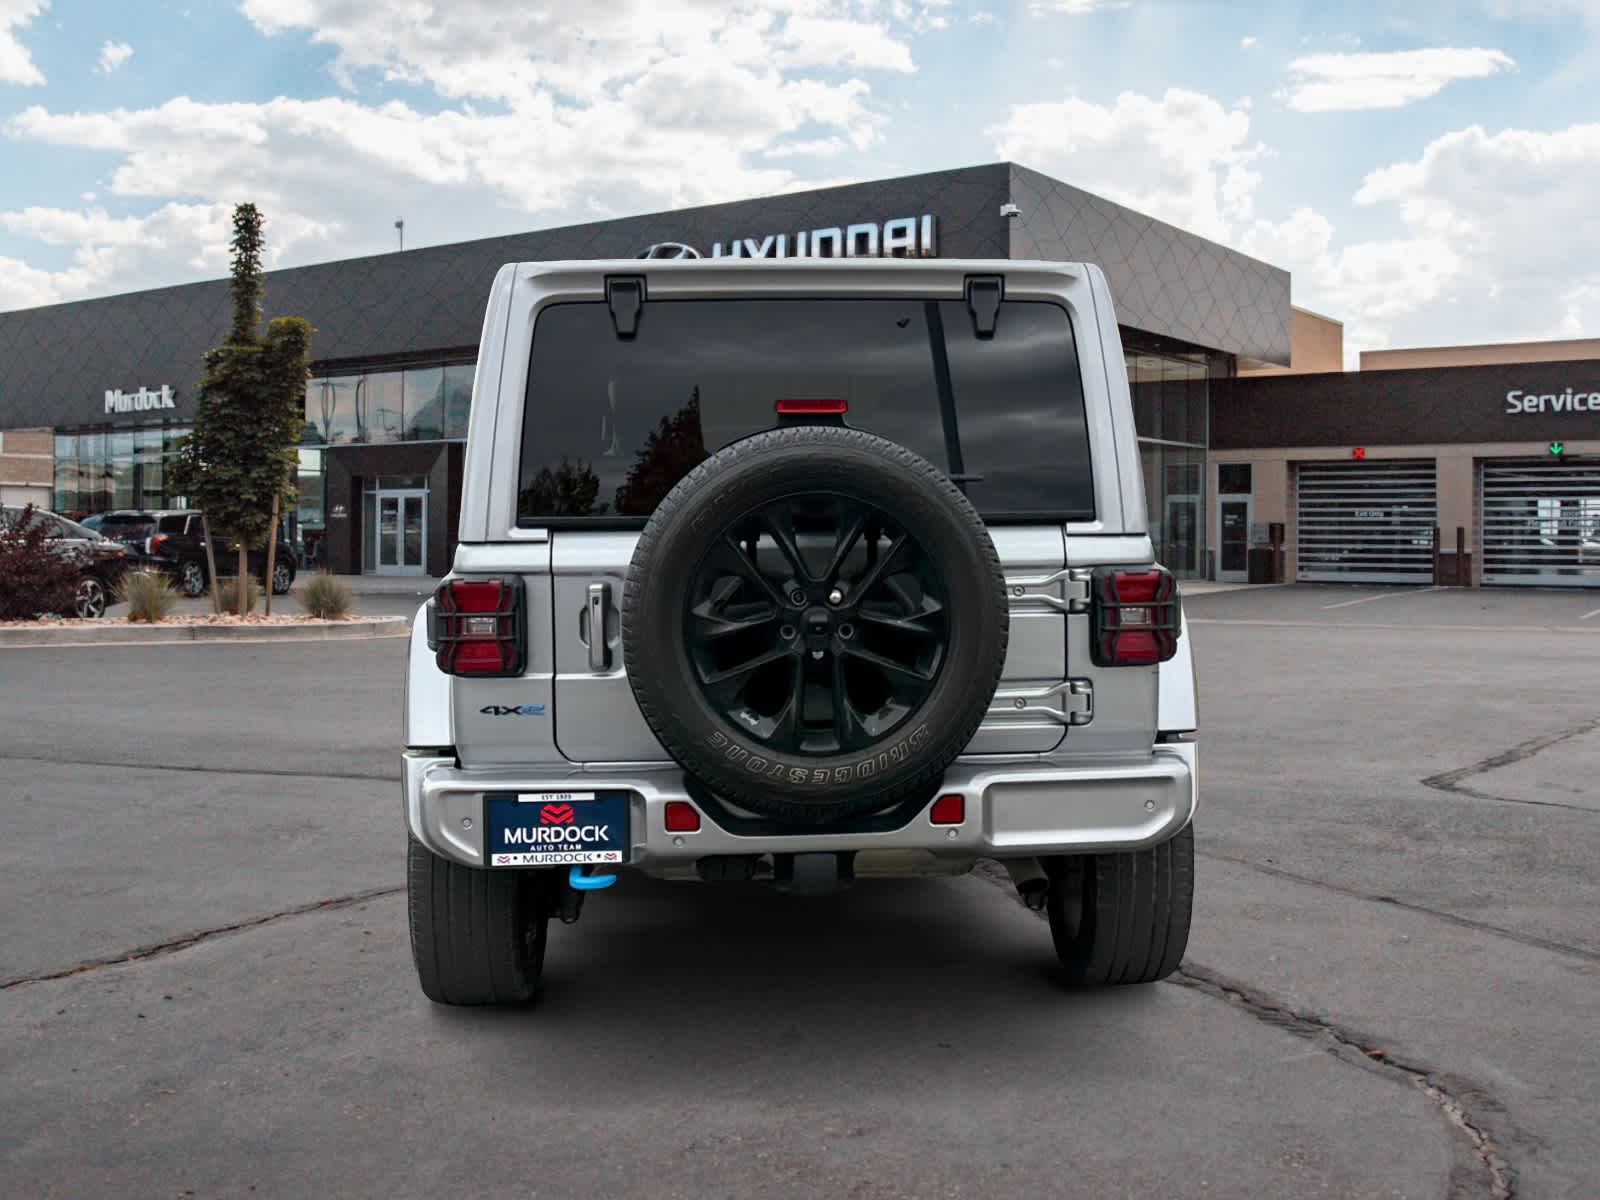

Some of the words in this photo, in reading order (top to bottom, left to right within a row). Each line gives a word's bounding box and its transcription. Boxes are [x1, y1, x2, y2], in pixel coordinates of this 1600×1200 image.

[104, 384, 176, 414] Murdock
[1505, 387, 1600, 414] Service
[708, 724, 929, 784] BRIDGESTONE
[504, 825, 609, 844] MURDOCK
[522, 853, 593, 863] MURDOCK
[530, 844, 554, 852] AUTO
[558, 843, 582, 851] TEAM
